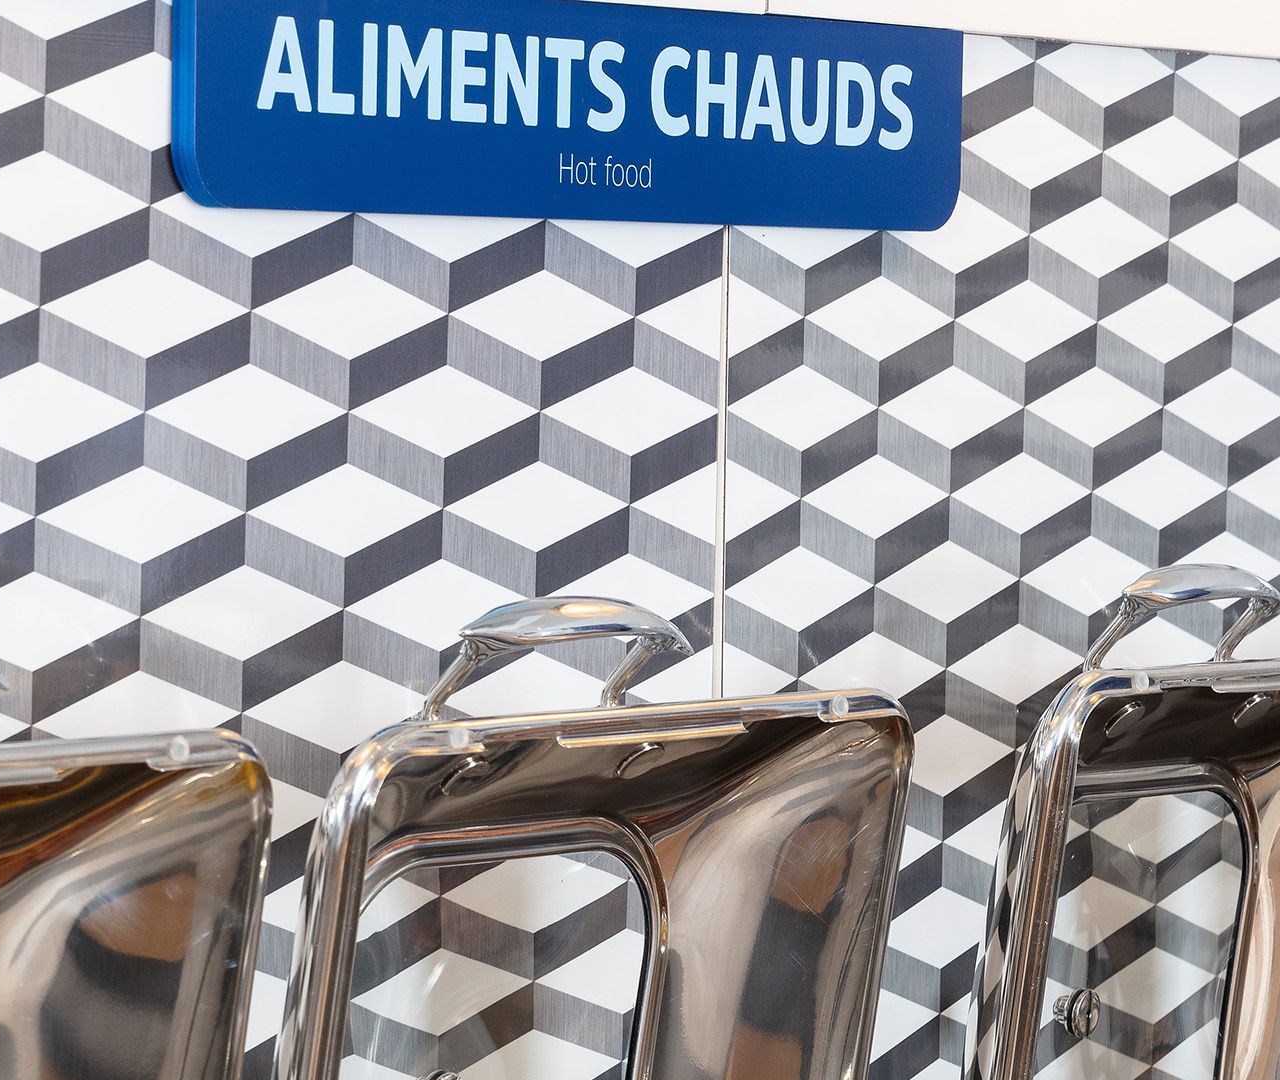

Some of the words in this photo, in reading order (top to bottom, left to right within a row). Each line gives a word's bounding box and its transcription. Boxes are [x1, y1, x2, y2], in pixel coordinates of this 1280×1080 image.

[256, 15, 626, 133] ALIMENTS
[650, 45, 914, 151] CHAUDS
[559, 153, 597, 186] Hot
[604, 155, 652, 188] food
